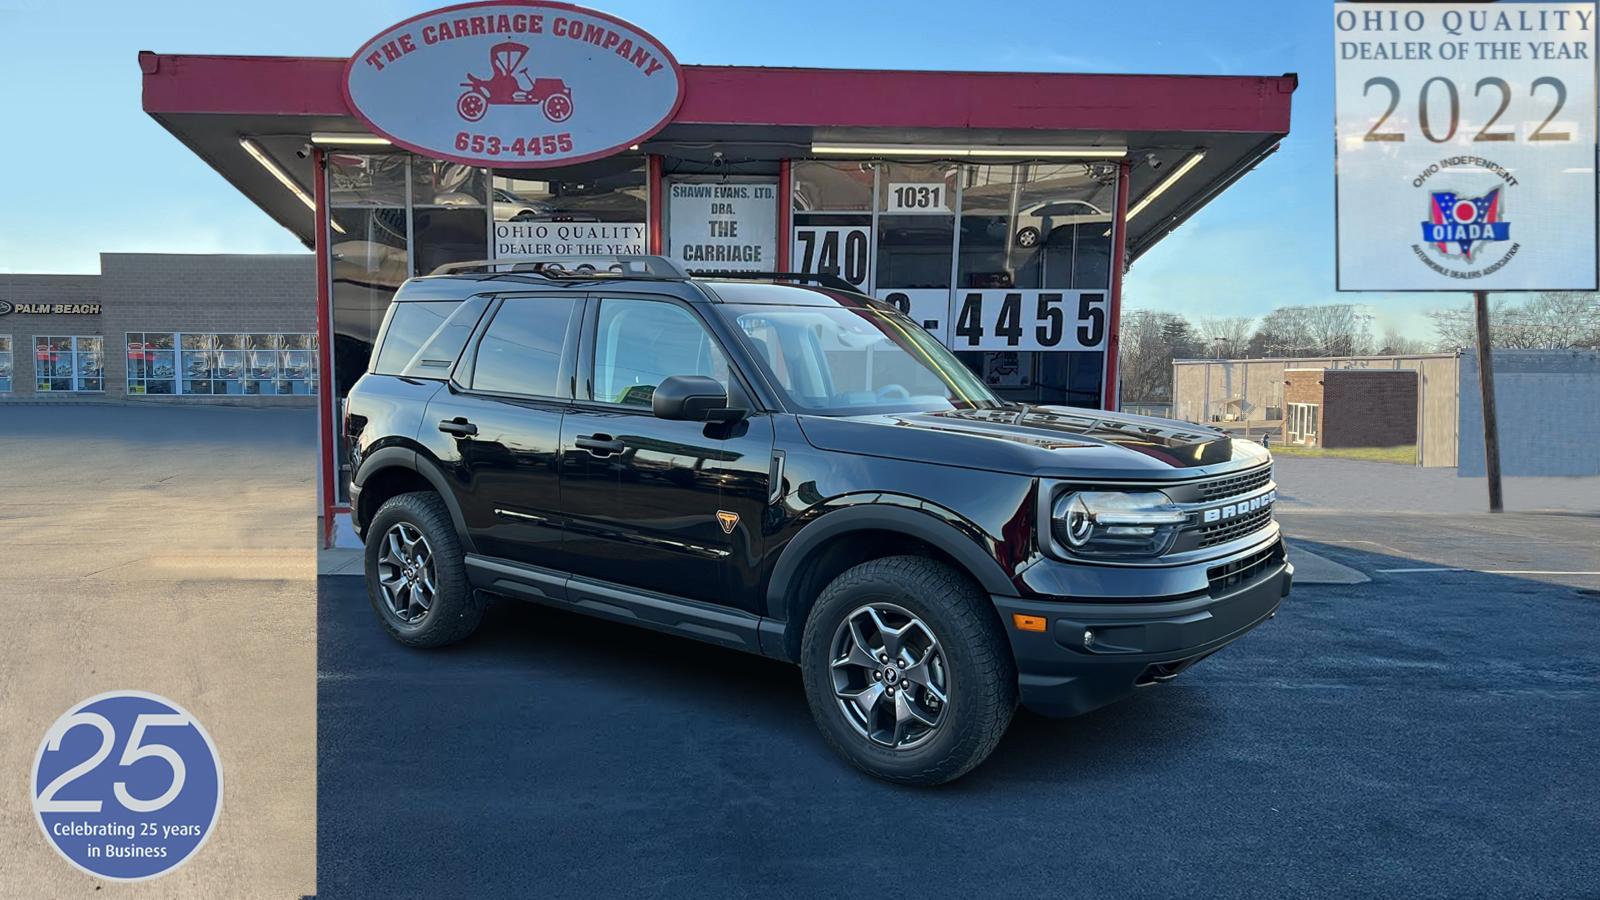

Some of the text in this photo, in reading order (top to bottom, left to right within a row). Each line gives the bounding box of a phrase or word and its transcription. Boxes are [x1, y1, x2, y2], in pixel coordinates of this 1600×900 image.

[1336, 10, 1593, 35] OHIO QUALITY
[365, 14, 664, 77] THE CARRIAGE COMPANY
[1340, 41, 1589, 60] DEALER OF THE YEAR
[1362, 76, 1571, 143] 2022
[455, 131, 573, 156] 653-4455
[1413, 156, 1519, 188] OHIO INDEPENDENT
[672, 186, 712, 199] SHAWN
[754, 187, 775, 199] LTD.
[894, 186, 940, 209] 1031
[711, 203, 736, 215] DBA.
[497, 225, 644, 241] OHIO QUALITY
[709, 220, 738, 238] THE
[1432, 223, 1496, 241] OIADA
[499, 243, 641, 255] DEALER OF THE YEAR
[683, 244, 762, 262] CARRIAGE
[797, 230, 868, 285] 740
[1411, 242, 1520, 280] AUTOMOBILE DEALERS ASSOCIATION
[15, 303, 100, 314] PALM BEACH
